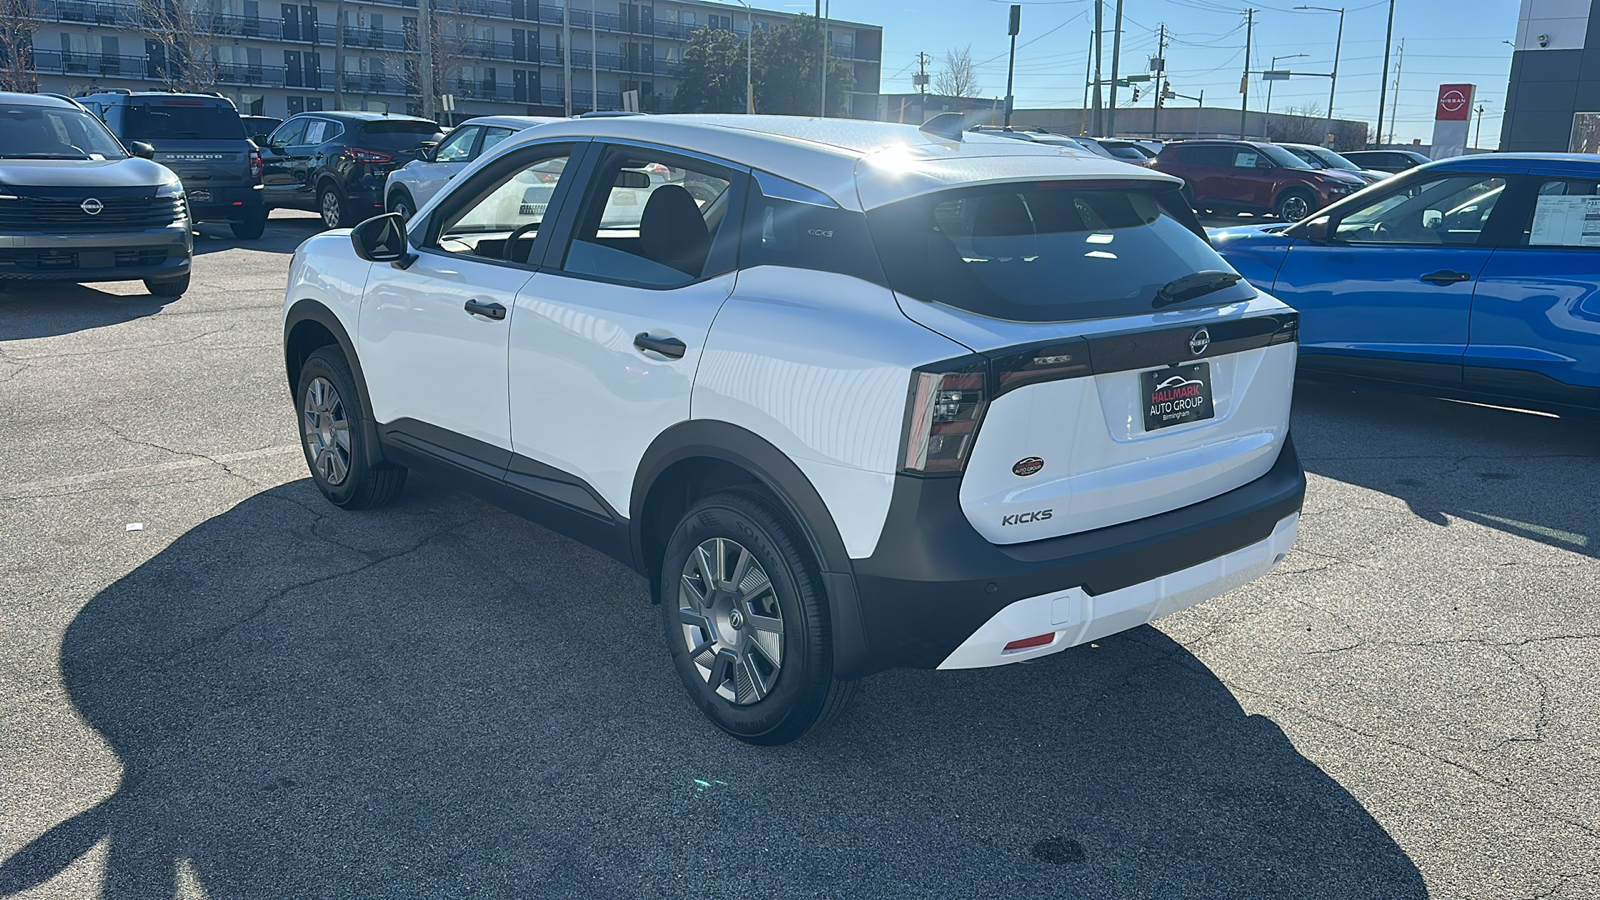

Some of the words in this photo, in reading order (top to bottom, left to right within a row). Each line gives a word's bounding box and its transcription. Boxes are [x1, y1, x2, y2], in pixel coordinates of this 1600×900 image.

[807, 228, 834, 238] KICKS
[1151, 384, 1200, 404] HALLMARK
[1150, 402, 1172, 416] AUTO
[1173, 396, 1204, 411] GROUP
[1162, 410, 1190, 421] Birmingham
[1001, 508, 1053, 527] KICKS
